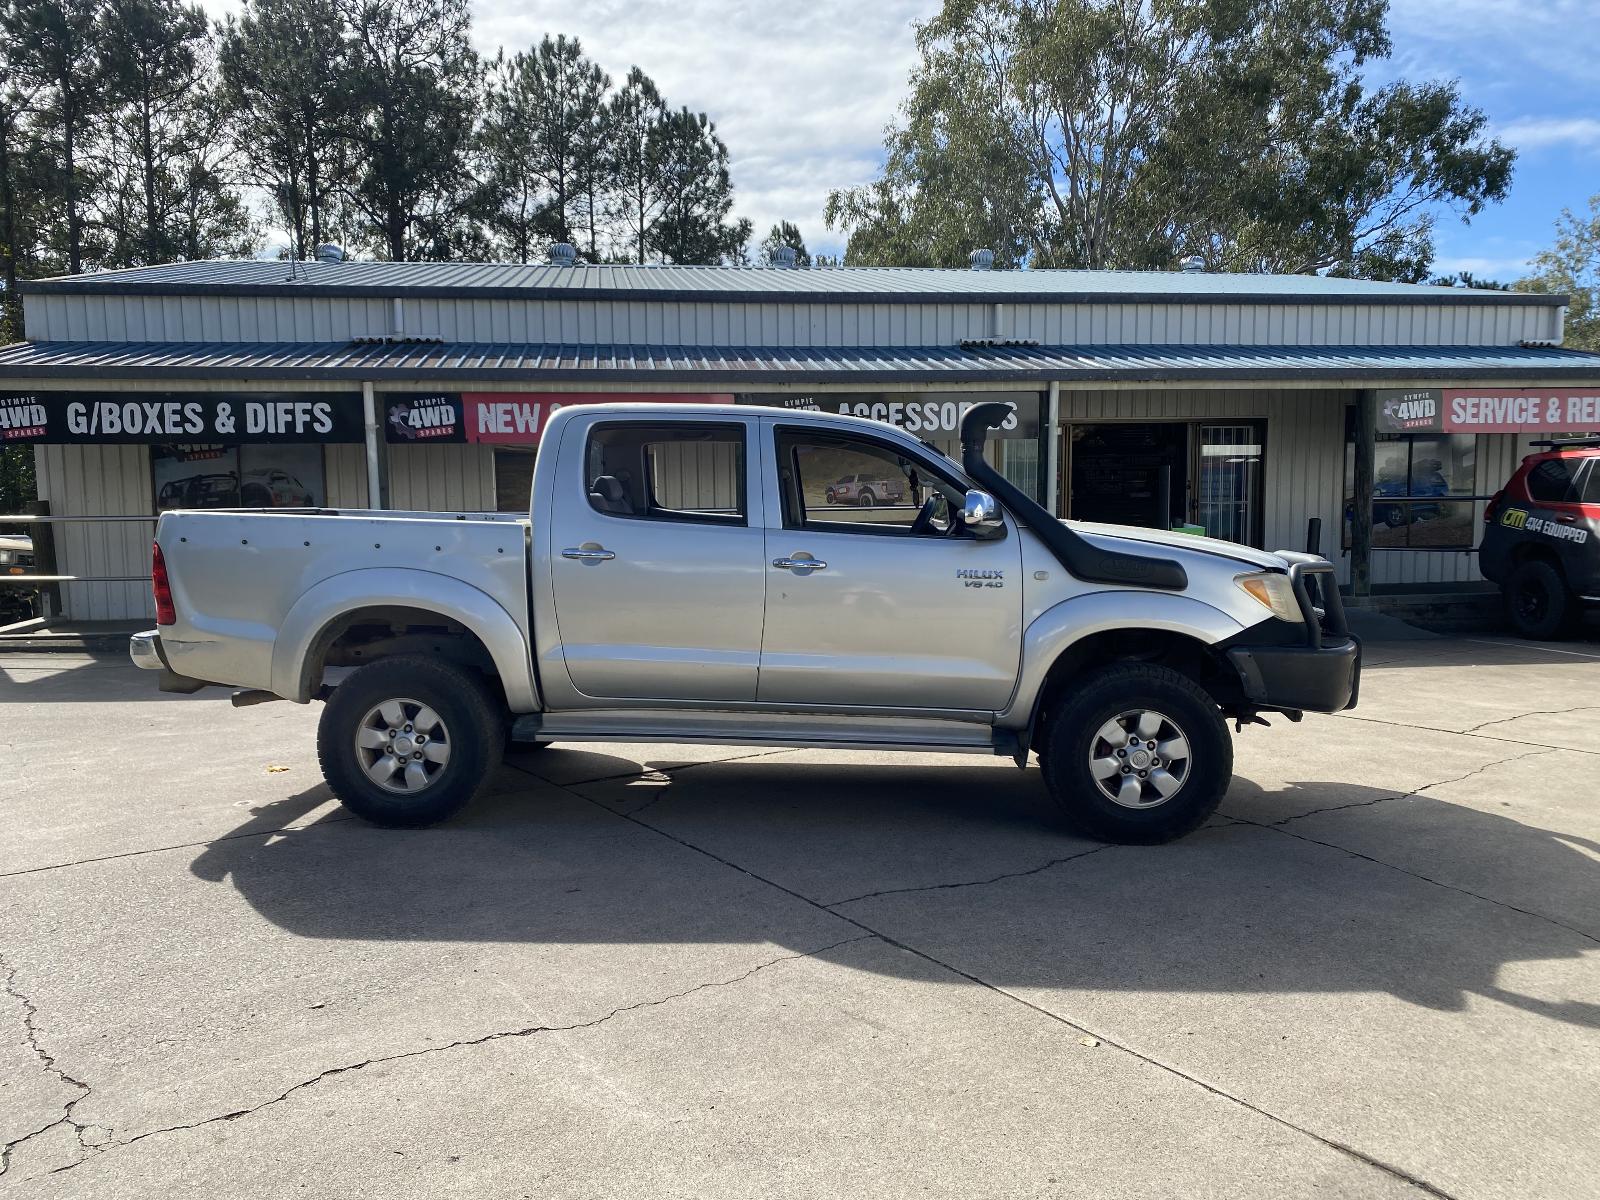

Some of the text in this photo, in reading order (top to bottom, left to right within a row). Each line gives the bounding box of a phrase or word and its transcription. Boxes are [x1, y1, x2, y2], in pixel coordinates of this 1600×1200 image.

[1, 396, 36, 406] GYMPIE
[413, 397, 446, 407] GYMPIE
[784, 397, 814, 407] GYMPIE
[1404, 392, 1430, 401] GYMPIE
[0, 404, 48, 429] 4WD
[66, 401, 333, 435] G/BOXES & DIFFS
[408, 404, 456, 429] 4WD
[477, 402, 541, 434] NEW
[839, 401, 1018, 432] CESSOS
[1397, 399, 1436, 420] 4WD
[1451, 397, 1541, 424] SERVICE
[1546, 397, 1562, 423] &
[8, 428, 45, 438] SPARES
[419, 427, 453, 437] SPARES
[1525, 517, 1544, 532] 4X4
[1542, 520, 1588, 544] EQUIPPED
[956, 569, 1004, 580] HILUX
